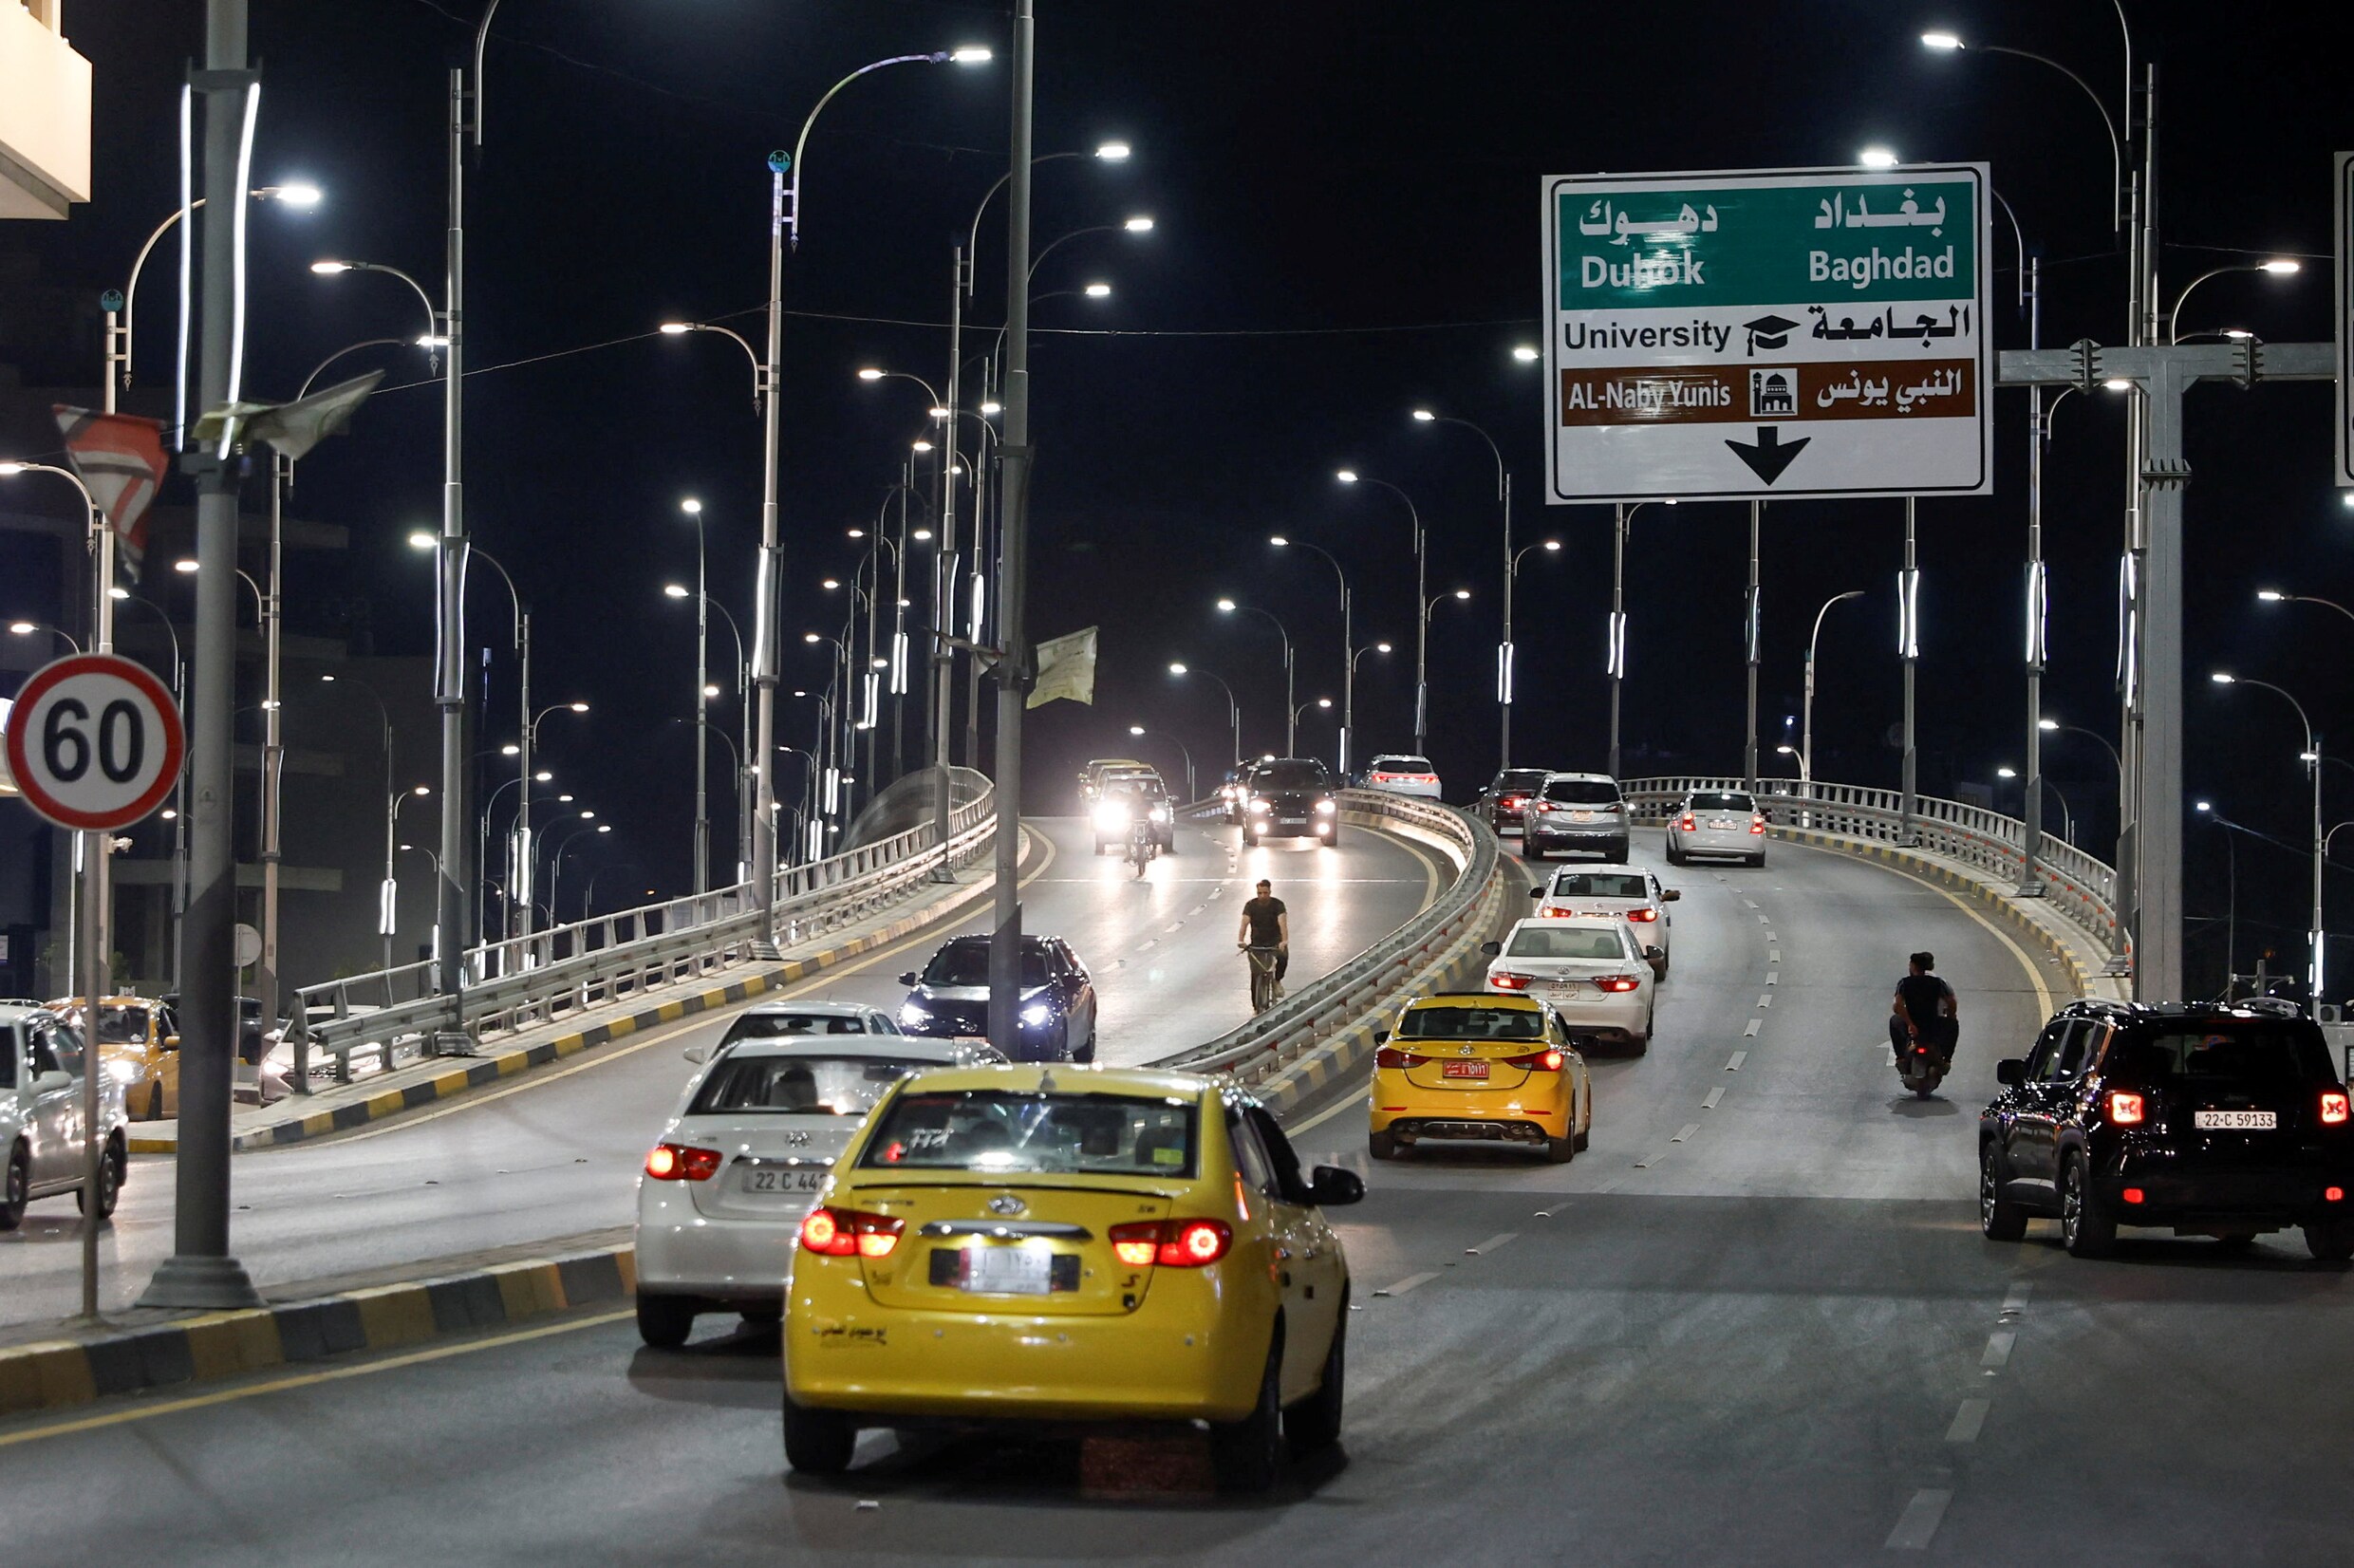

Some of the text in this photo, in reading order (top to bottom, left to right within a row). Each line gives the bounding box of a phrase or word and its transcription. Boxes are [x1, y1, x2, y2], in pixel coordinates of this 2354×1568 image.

[1579, 199, 1718, 245] دهوك
[1815, 188, 1946, 237] بغداد
[1581, 250, 1705, 289] Duhok
[1809, 245, 1954, 289] Baghdad
[1565, 320, 1731, 353] University
[1807, 304, 1970, 348] الجامعة
[1569, 380, 1731, 414] AL-Naby Yunis
[1817, 367, 1962, 413] النبي يونس
[44, 698, 144, 784] 60
[2205, 1113, 2219, 1127] 22
[2224, 1113, 2233, 1127] C
[2236, 1113, 2273, 1127] 59133
[756, 1172, 775, 1190] 22
[782, 1173, 792, 1189] C
